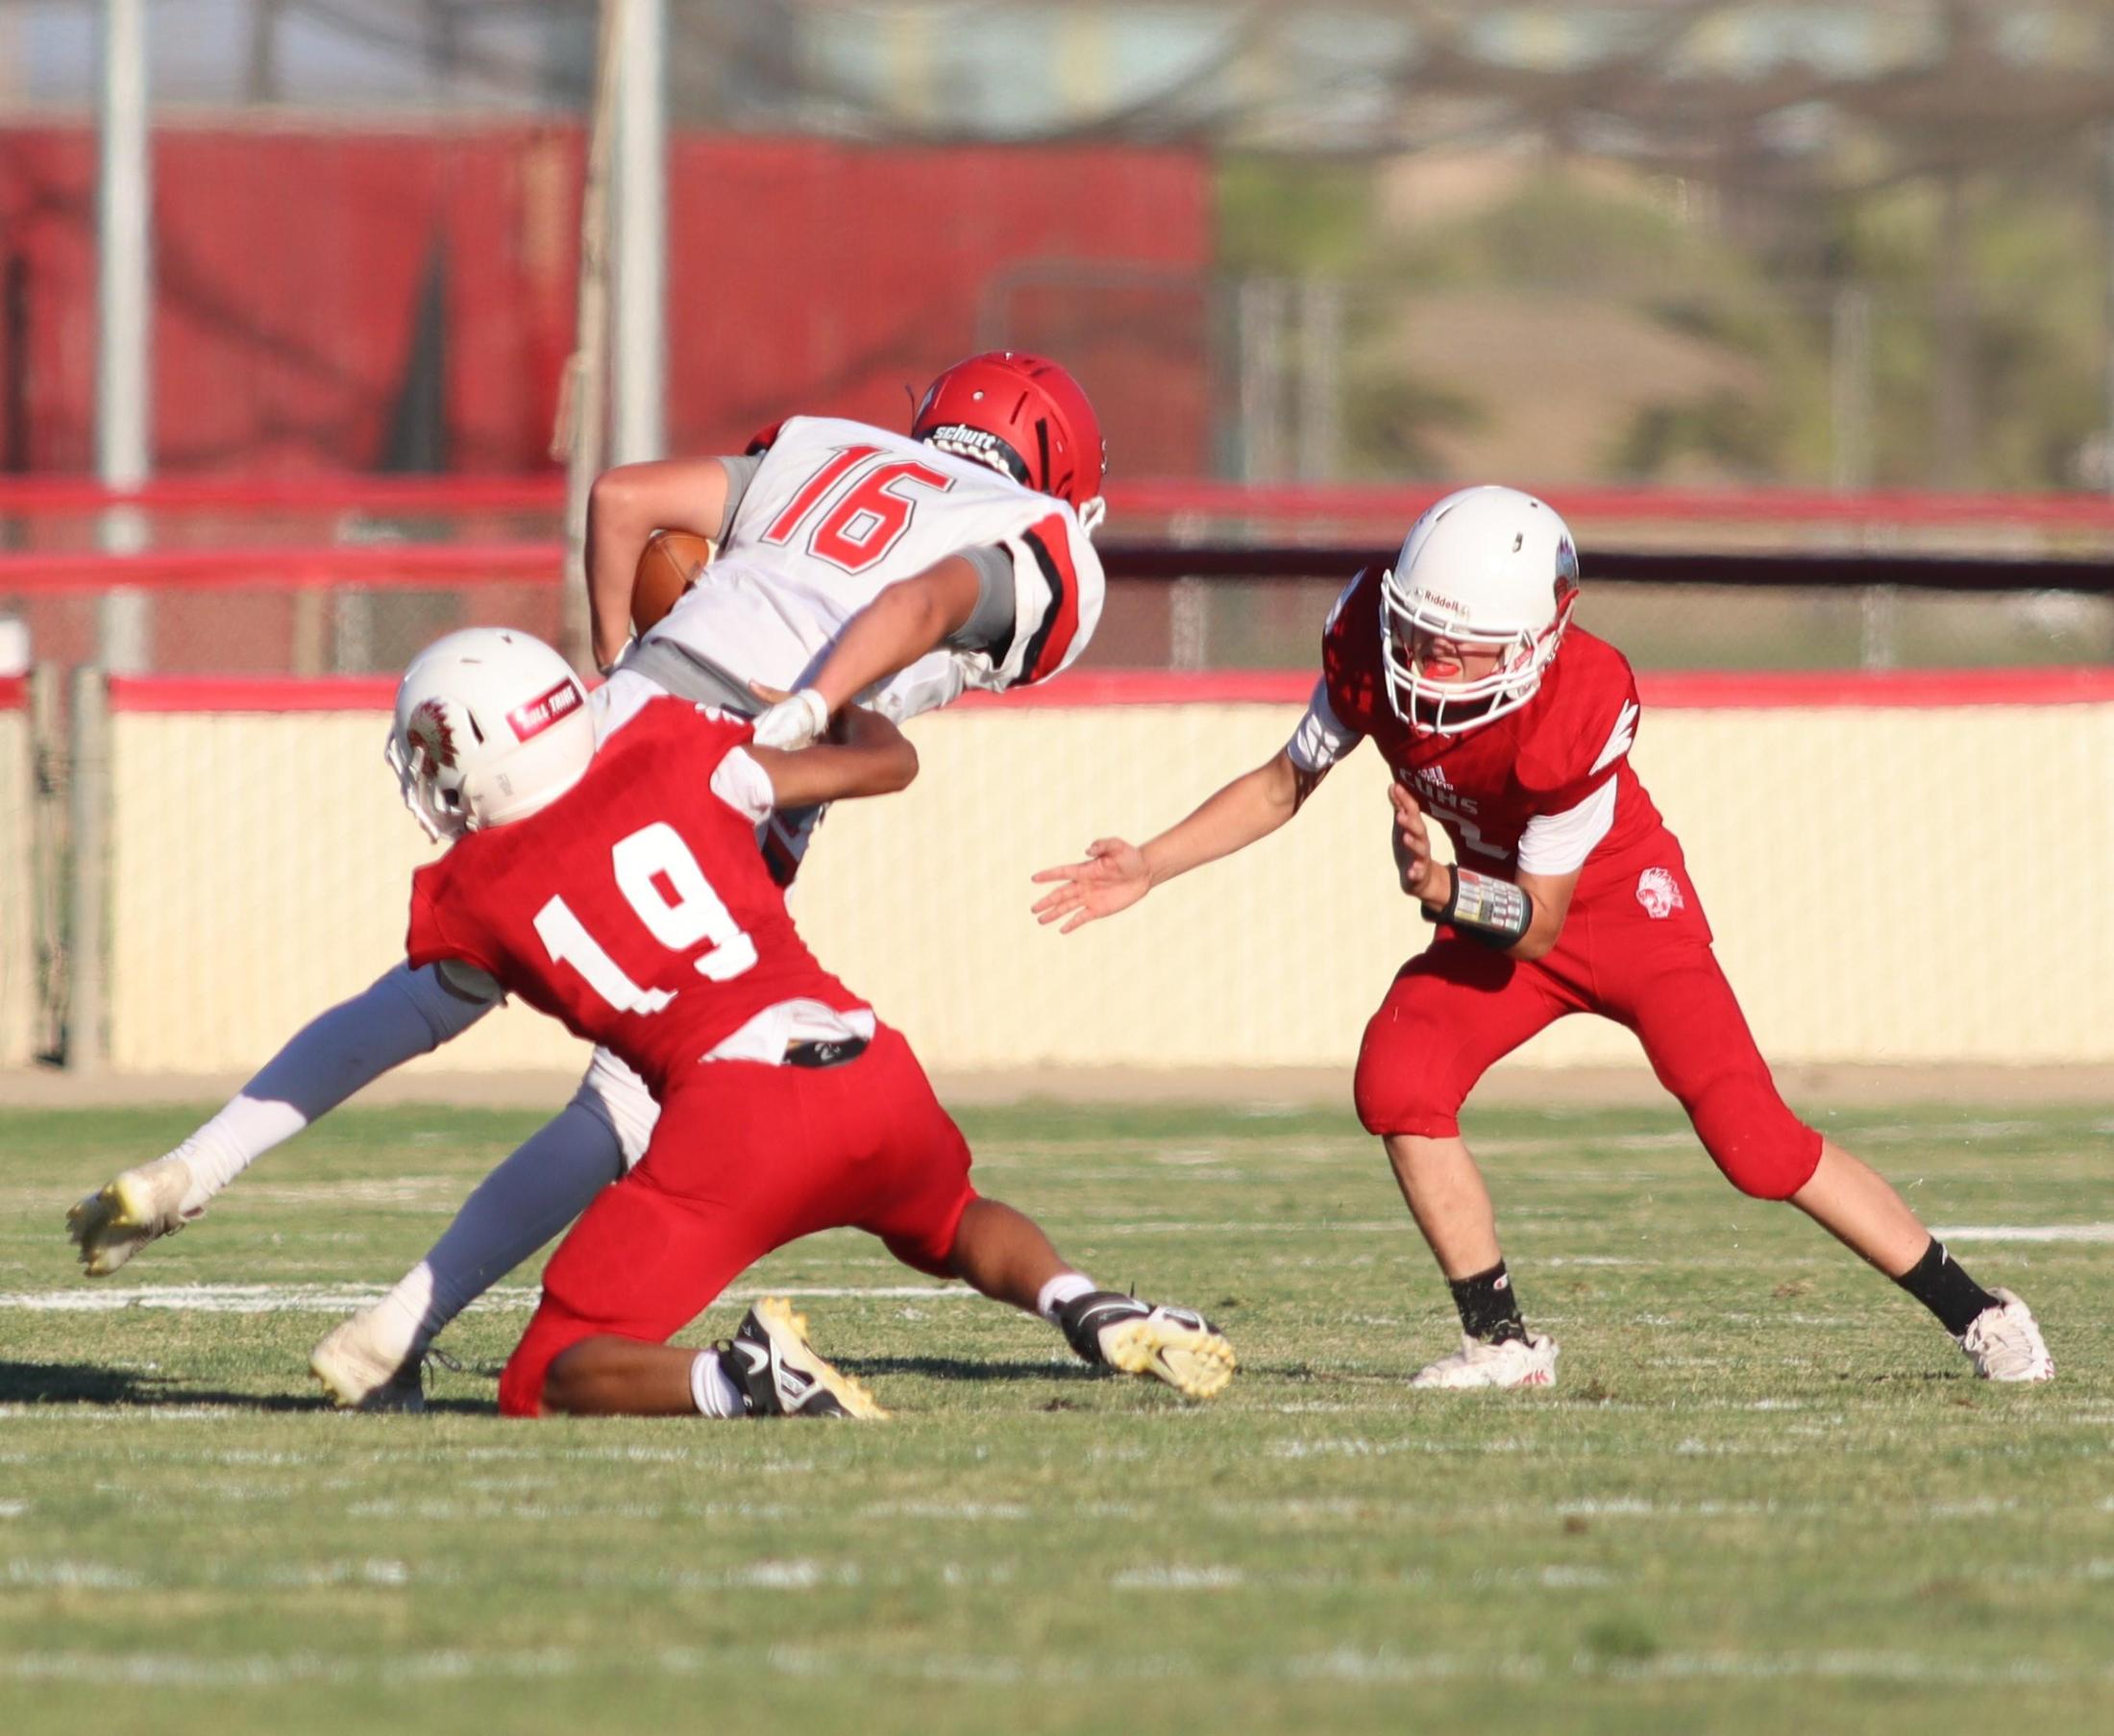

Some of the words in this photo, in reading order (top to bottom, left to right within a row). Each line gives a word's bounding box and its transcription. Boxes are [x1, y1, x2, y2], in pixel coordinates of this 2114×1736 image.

[933, 425, 996, 450] schutt
[759, 444, 956, 575] 16
[1424, 590, 1459, 611] Riddell
[1429, 801, 1511, 861] 2
[532, 821, 758, 1016] 19
